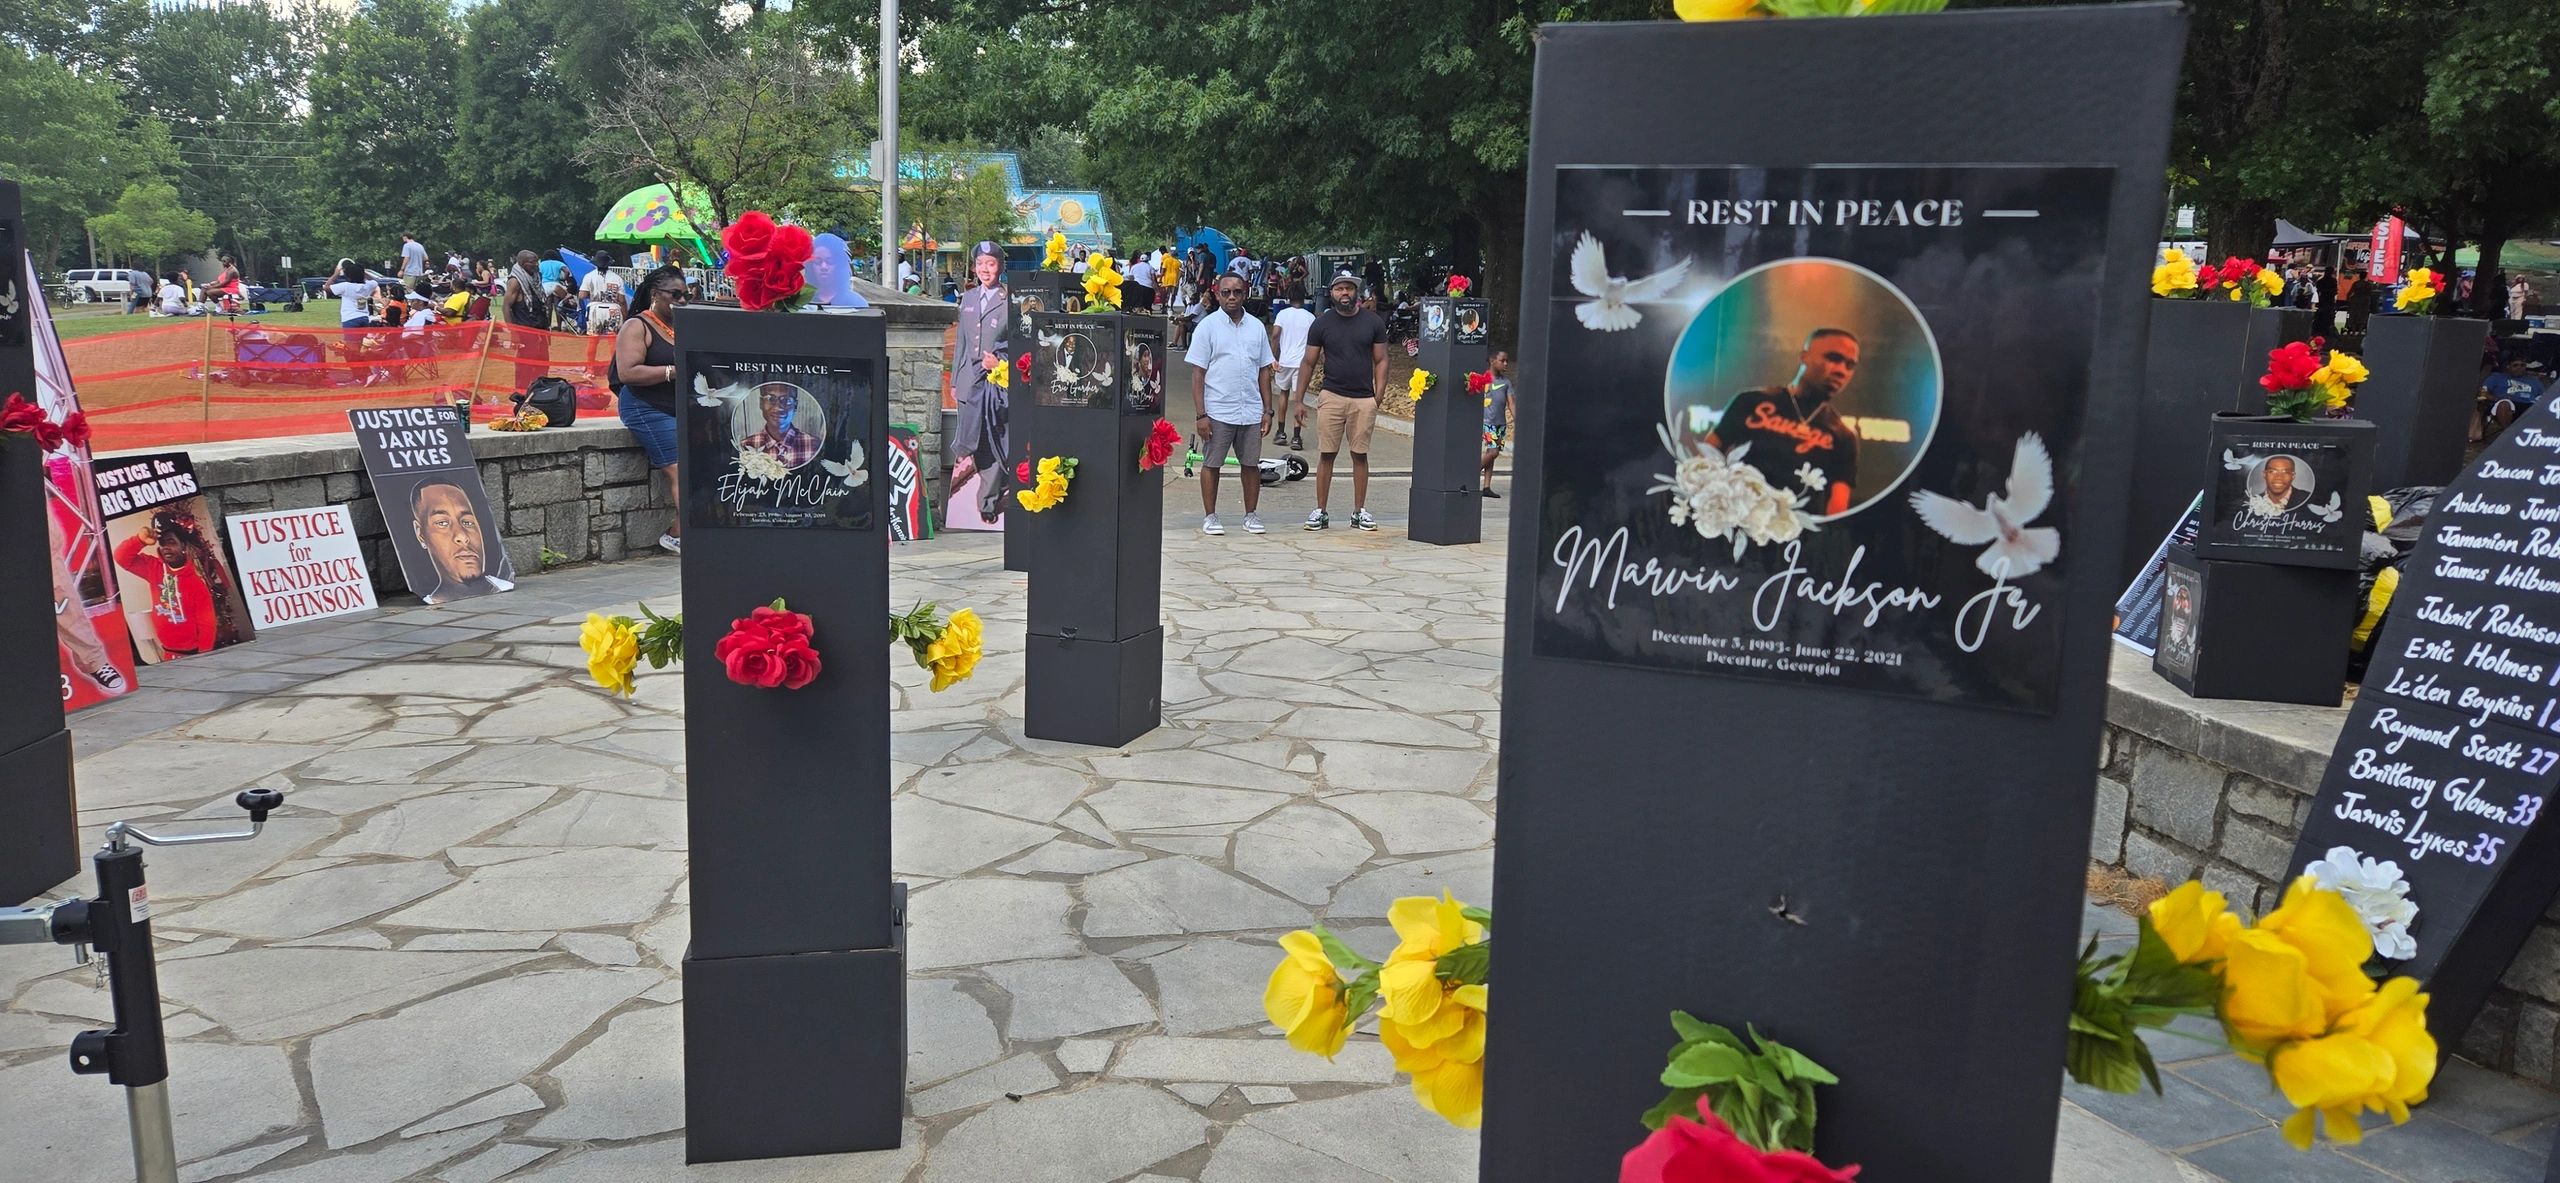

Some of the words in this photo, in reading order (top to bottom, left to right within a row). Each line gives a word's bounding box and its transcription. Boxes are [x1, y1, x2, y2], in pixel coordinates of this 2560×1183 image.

[1687, 200, 1778, 225] REST
[1788, 200, 1822, 226] IN
[1835, 200, 1964, 227] PEACE
[735, 362, 767, 372] REST
[770, 363, 783, 373] IN
[787, 364, 828, 375] PEACE
[358, 408, 437, 429] JUSTICE
[437, 411, 457, 421] FOR
[380, 429, 449, 449] JARVIS
[388, 447, 451, 468] LYKES
[2478, 460, 2534, 480] Deacon
[96, 463, 152, 489] USTICE
[154, 460, 176, 475] for
[128, 473, 198, 508] HOLMES
[717, 472, 769, 512] Elijah
[773, 474, 849, 508] McClain
[2443, 492, 2511, 515] Andrew
[240, 511, 344, 551] JUSTICE
[2279, 513, 2326, 534] Harris
[289, 542, 311, 562] for
[2437, 526, 2518, 553] Jamarion
[247, 557, 363, 596] KENDRICK
[2435, 555, 2490, 581] James
[264, 584, 365, 624] JOHNSON
[1553, 525, 1739, 614] Marvin
[1752, 539, 1942, 632] Jackson
[1954, 555, 2042, 653] Jr
[2416, 596, 2484, 630] Jabril
[1652, 628, 1728, 649] December
[1795, 643, 1831, 658] June
[1834, 646, 1860, 662] 22,
[1864, 649, 1902, 666] 2021
[2404, 638, 2455, 663] Eric
[2463, 642, 2543, 682] Holmes
[1706, 650, 1773, 669] Decatur,
[1777, 657, 1841, 677] Georgia
[2457, 687, 2535, 728] Boykins
[2370, 708, 2460, 755] Raymond
[2462, 734, 2522, 769] Scott
[2521, 748, 2559, 775] 27
[2349, 748, 2437, 809] Brittany
[2443, 778, 2508, 824] Glover
[2507, 795, 2543, 826] 33
[2335, 792, 2406, 835] Jarvis
[2403, 810, 2468, 860] Lykes
[2465, 833, 2505, 865] 35
